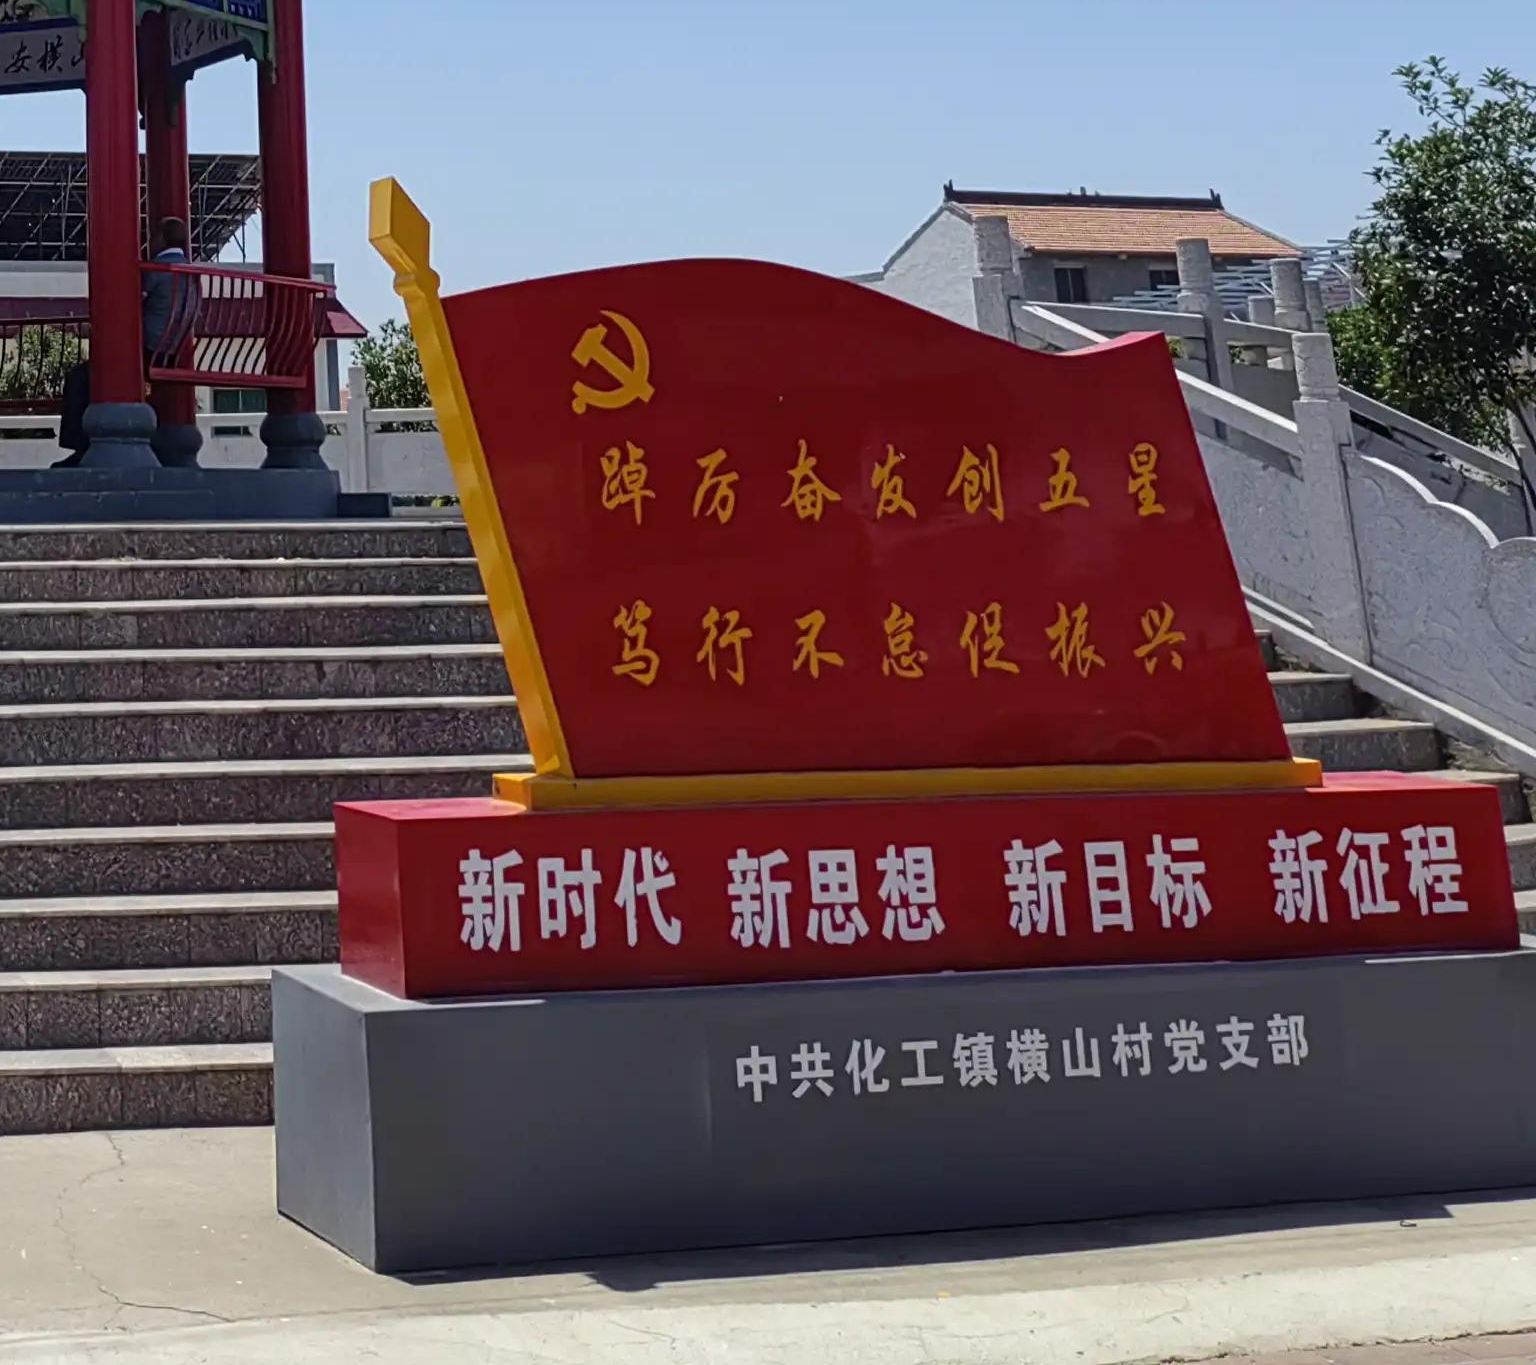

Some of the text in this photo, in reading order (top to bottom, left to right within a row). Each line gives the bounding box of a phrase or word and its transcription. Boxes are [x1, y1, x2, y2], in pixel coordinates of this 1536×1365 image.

[600, 439, 1166, 525] 踔厉奋发创五星
[611, 600, 1186, 686] 笃行不怠促振兴
[458, 823, 1470, 951] 新时代 新思想 新目标 新征程
[735, 1012, 1311, 1103] 中共化工镇横山村党支部
